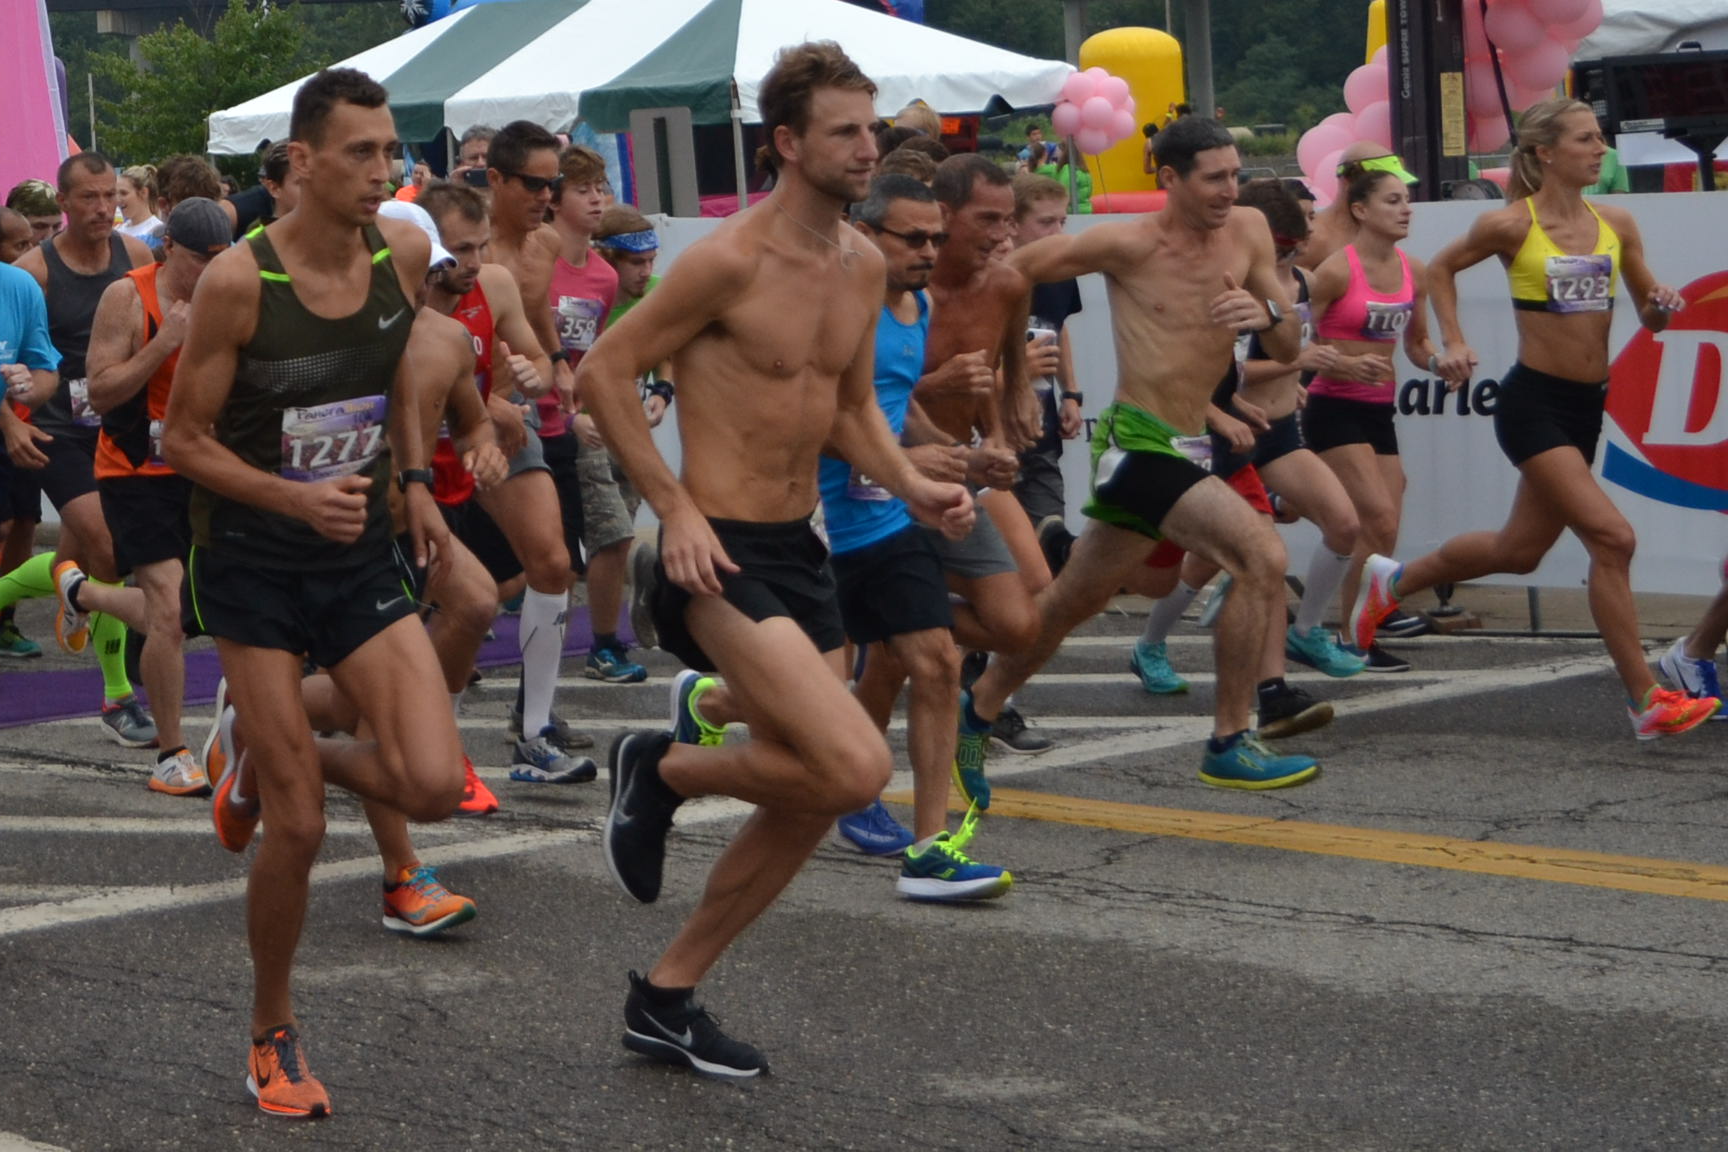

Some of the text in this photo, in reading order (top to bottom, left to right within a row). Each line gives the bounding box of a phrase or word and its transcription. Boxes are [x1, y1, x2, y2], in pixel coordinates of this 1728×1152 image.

[1551, 276, 1610, 300] 1293
[1393, 376, 1500, 417] arle
[289, 424, 382, 469] 1277
